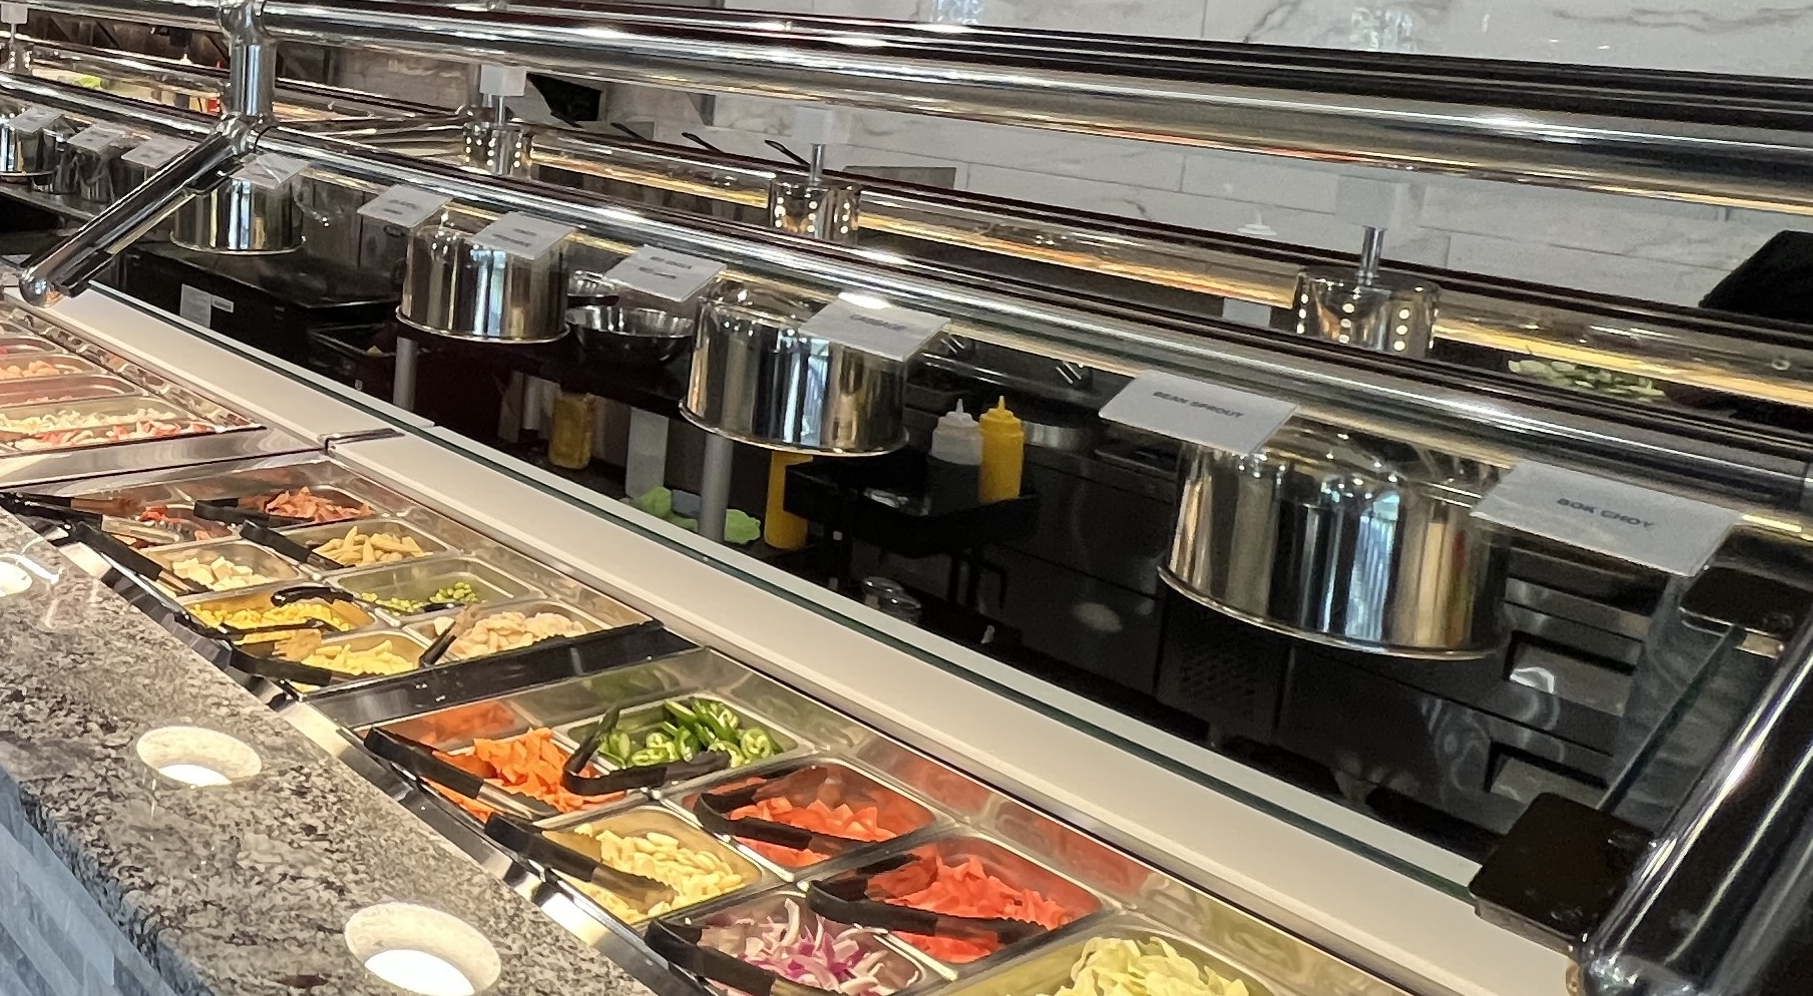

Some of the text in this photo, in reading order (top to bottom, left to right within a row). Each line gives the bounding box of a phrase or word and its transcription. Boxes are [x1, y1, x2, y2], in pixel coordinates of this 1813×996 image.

[1152, 391, 1244, 418] BEAN SPROUT
[1556, 498, 1654, 528] BOK CHOY
